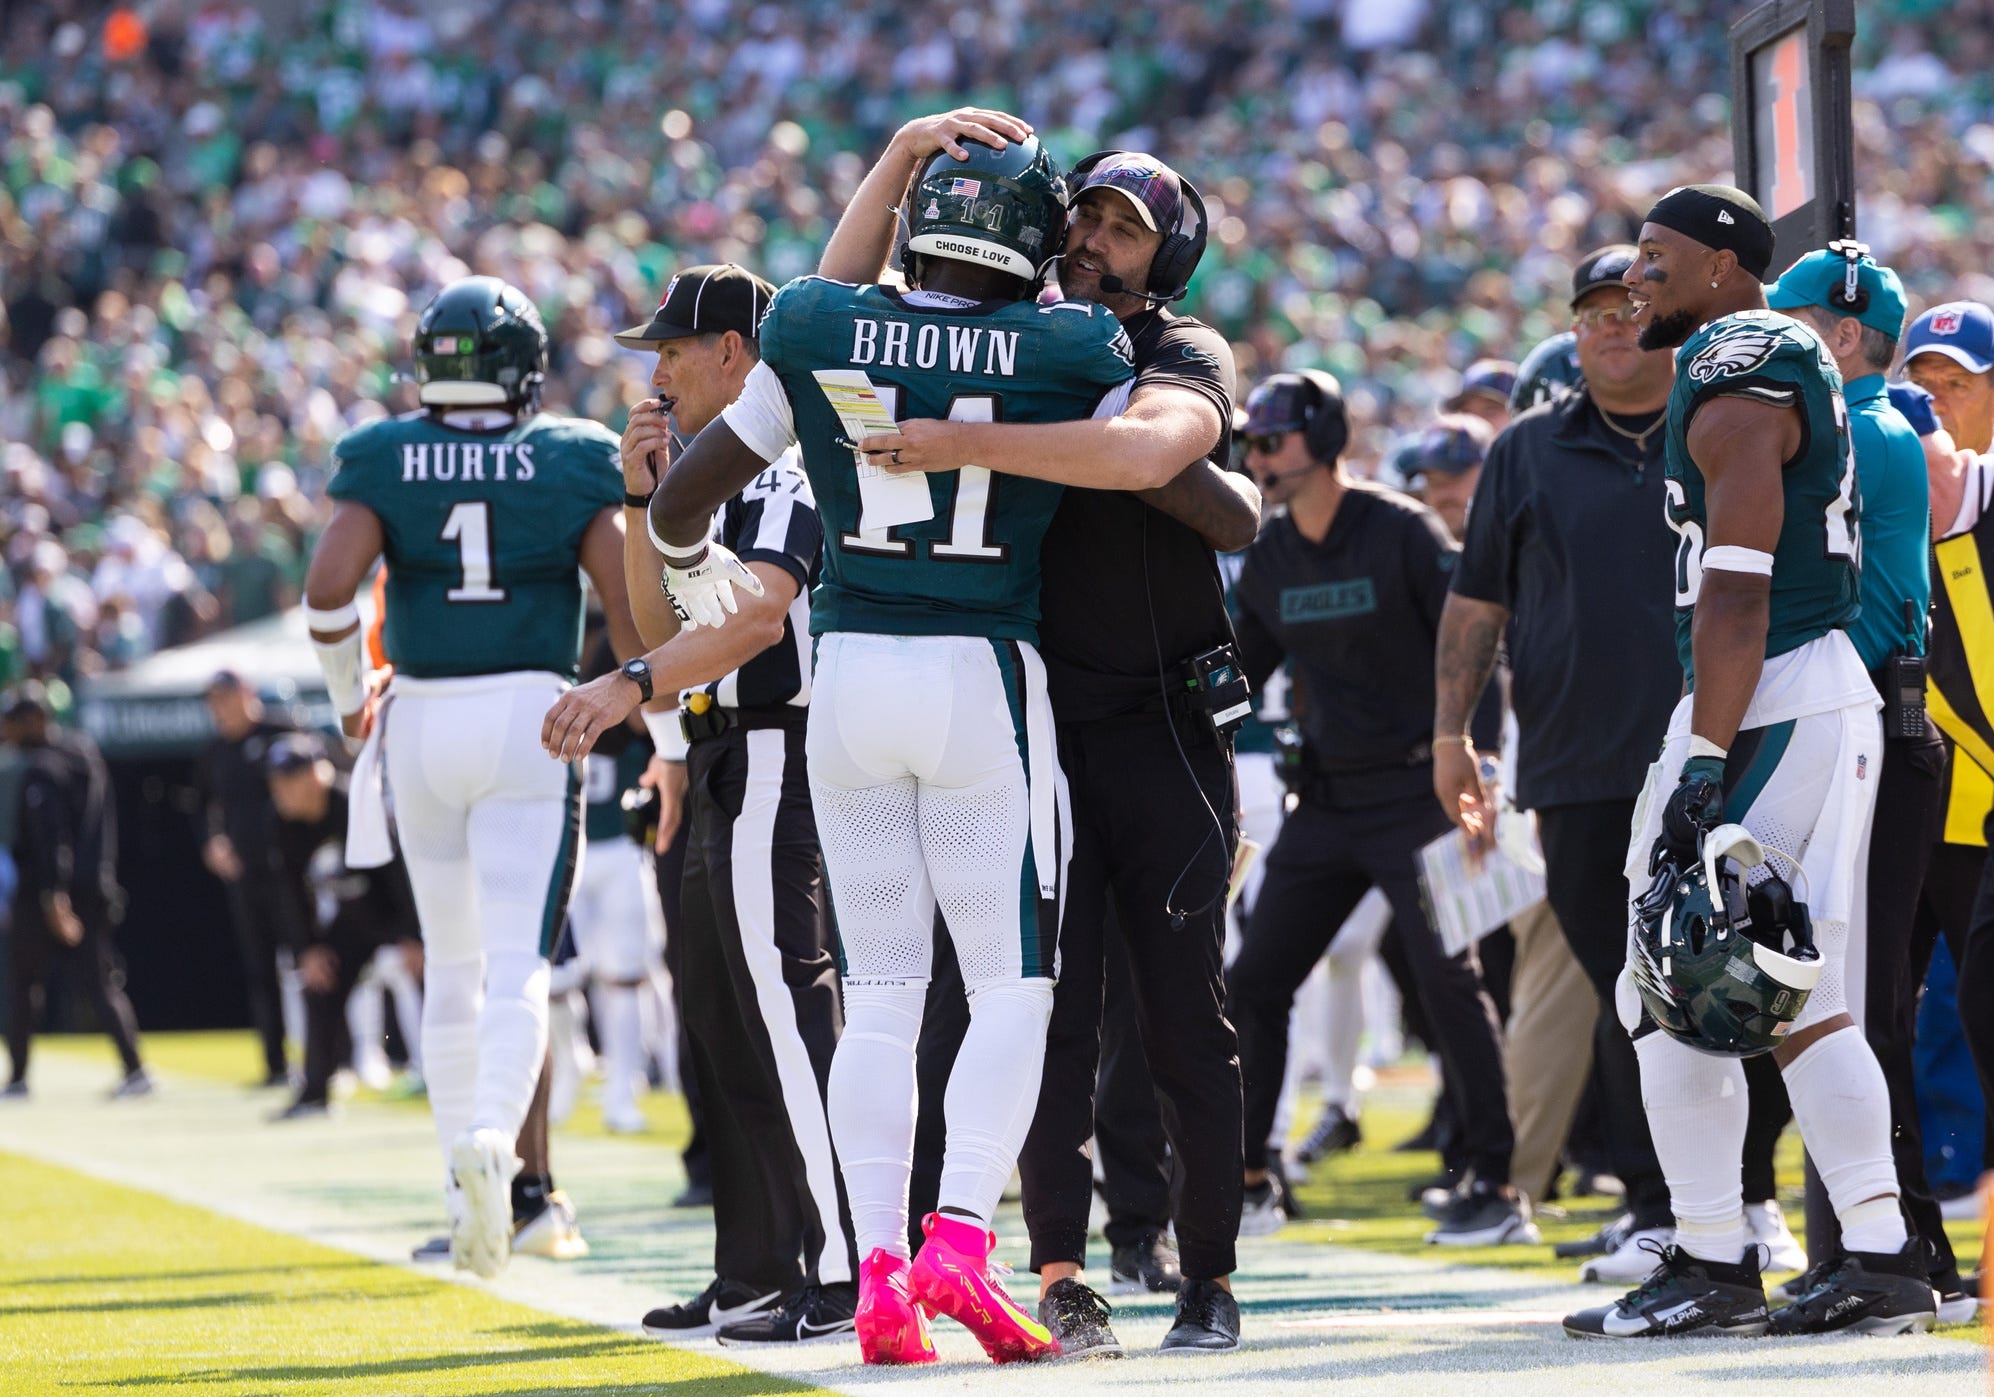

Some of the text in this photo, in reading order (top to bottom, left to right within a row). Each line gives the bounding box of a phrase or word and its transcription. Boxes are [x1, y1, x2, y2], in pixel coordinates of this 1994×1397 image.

[1770, 37, 1805, 221] 1
[960, 197, 1004, 231] 11
[936, 240, 1011, 265] CHOOSE LOVE
[925, 292, 977, 309] NIKE PRO
[850, 318, 1020, 376] BROWN
[401, 442, 536, 482] HURTS
[755, 470, 806, 494] 47
[440, 501, 507, 601] 1
[1664, 1306, 1703, 1329] ALPHA
[1824, 1294, 1864, 1321] ALPHA
